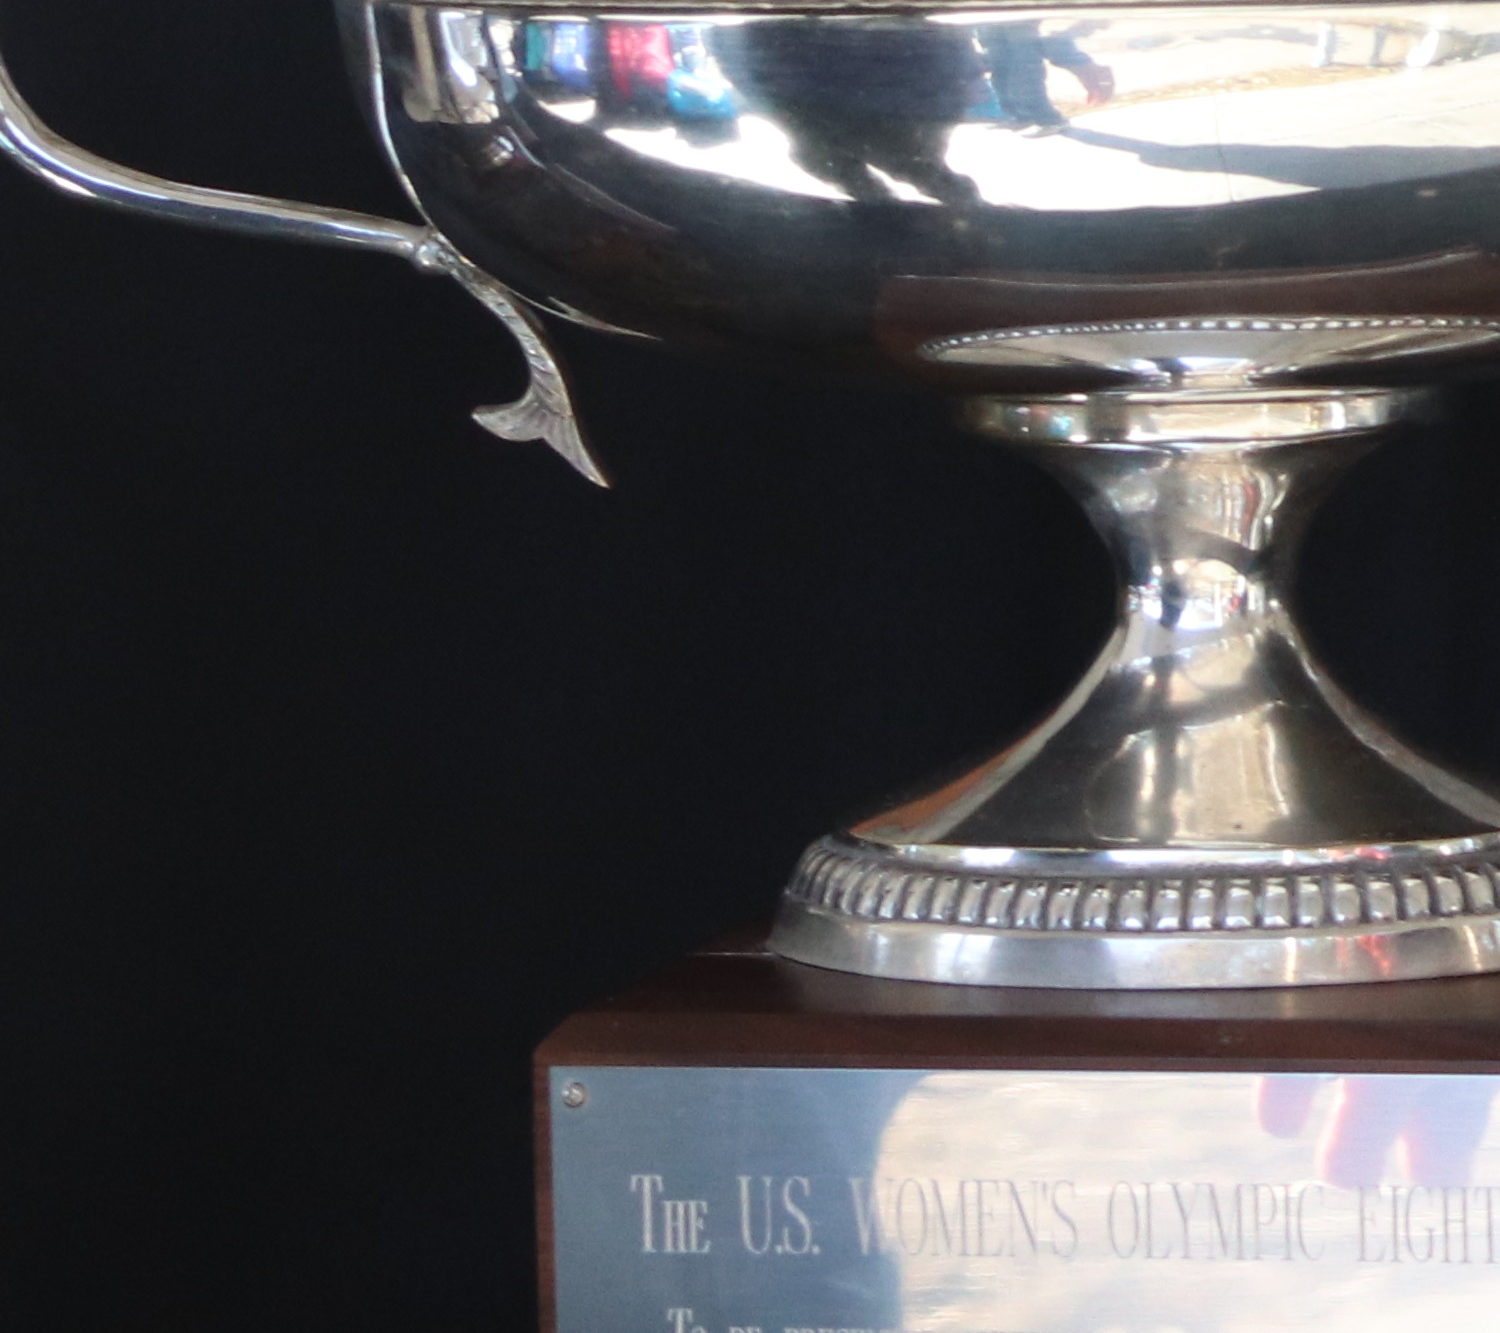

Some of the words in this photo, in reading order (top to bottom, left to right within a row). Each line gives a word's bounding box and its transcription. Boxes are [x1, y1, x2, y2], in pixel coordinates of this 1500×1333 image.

[631, 1174, 711, 1254] THE
[738, 1174, 820, 1257] U.S.
[852, 1176, 1079, 1262] WOMEN'S
[1107, 1180, 1325, 1265] OLYMPIC
